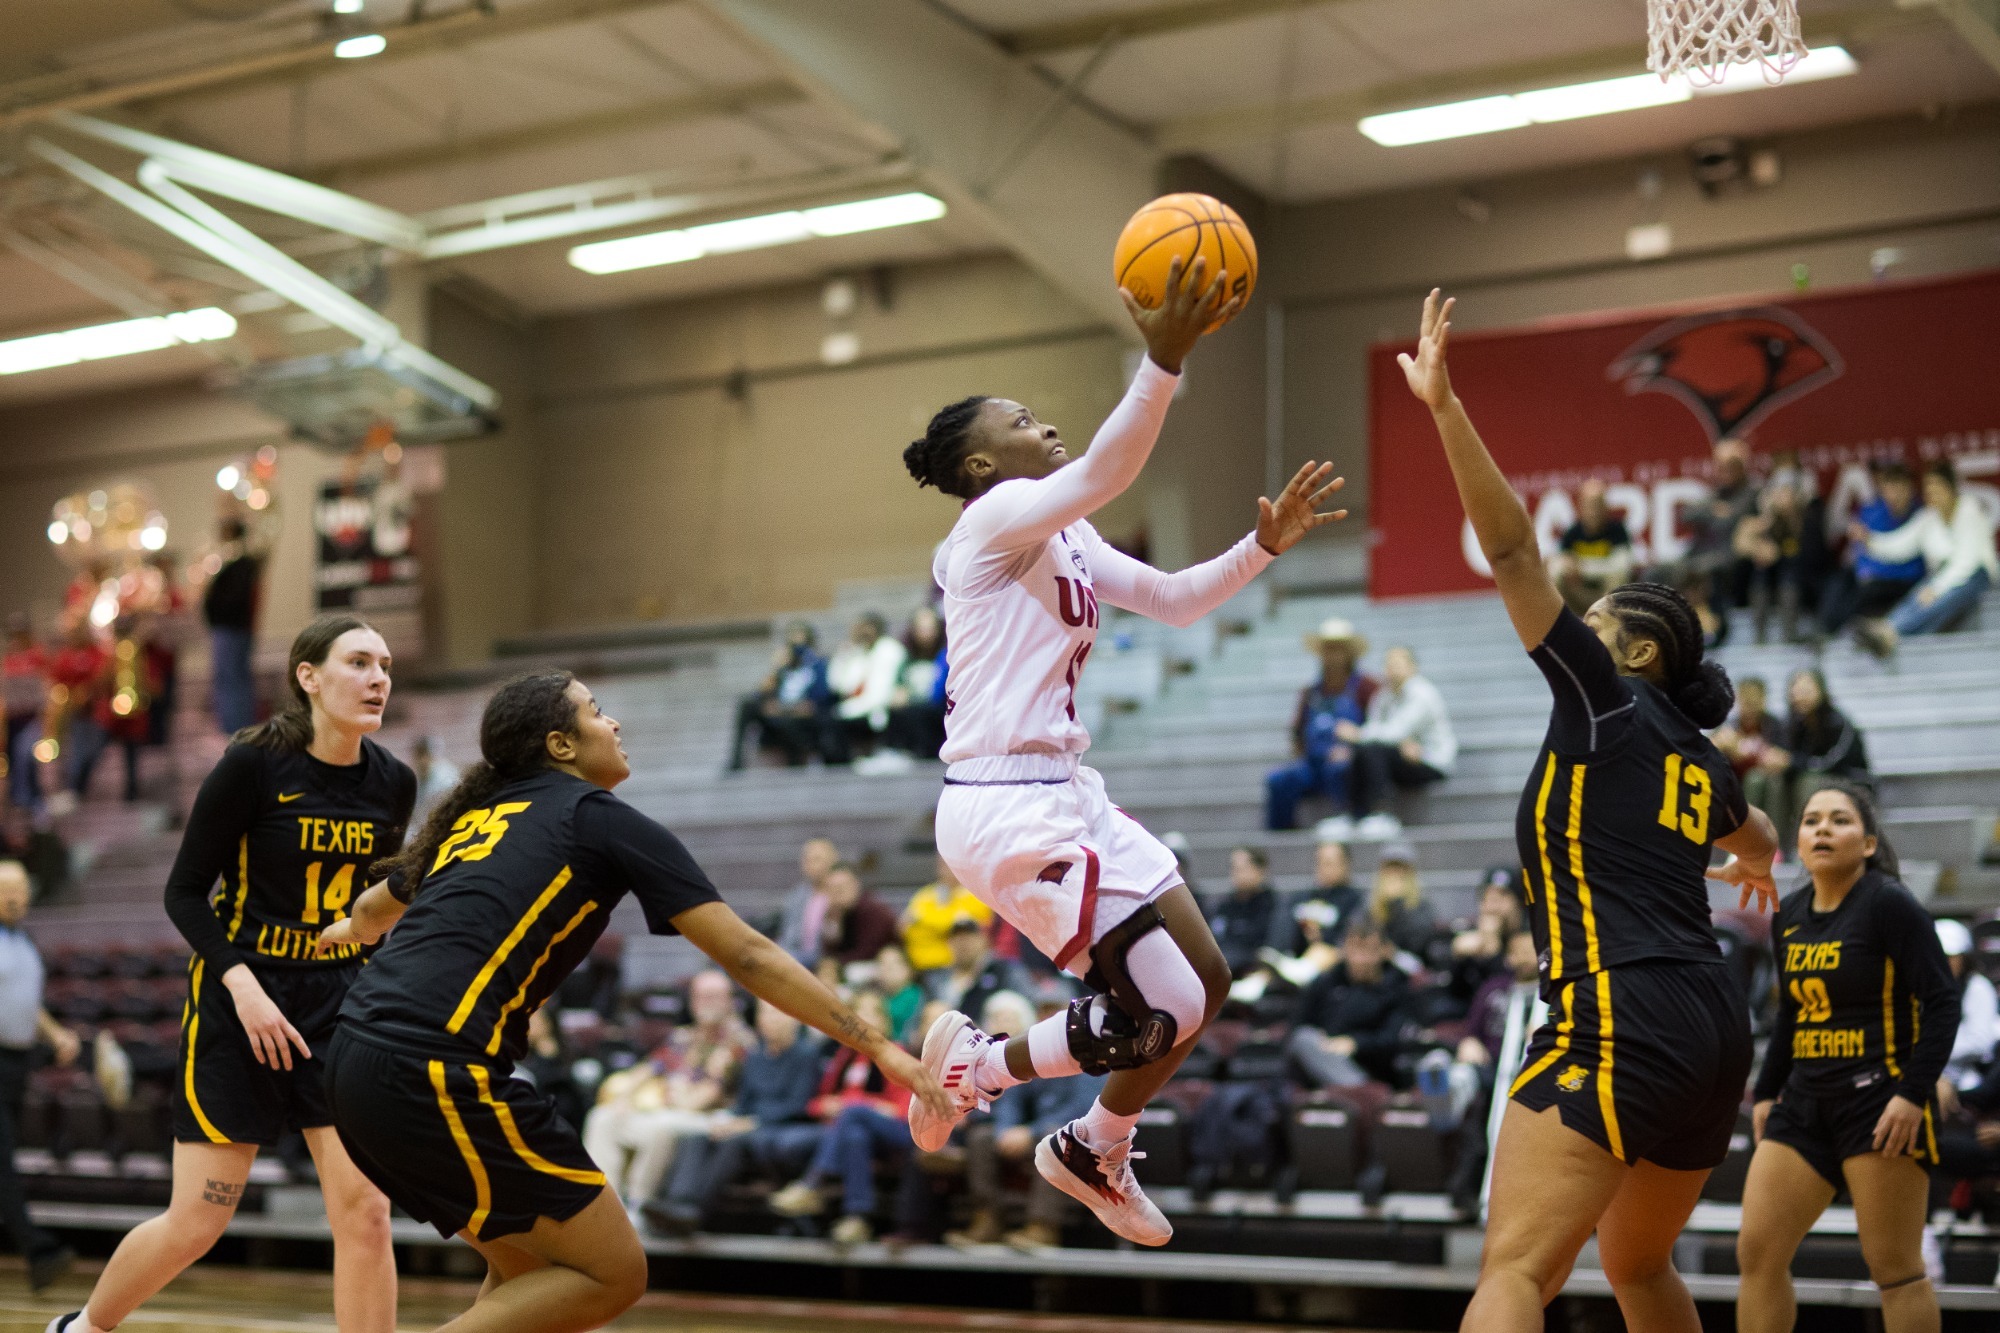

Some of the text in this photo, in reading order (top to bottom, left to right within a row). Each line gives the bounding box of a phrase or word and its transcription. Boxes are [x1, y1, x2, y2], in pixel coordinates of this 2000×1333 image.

[1657, 753, 1712, 845] 13
[298, 817, 374, 854] TEXAS
[426, 801, 532, 878] 25
[301, 861, 356, 924] 14
[257, 923, 361, 960] LUTH
[1784, 940, 1842, 972] TEXAS
